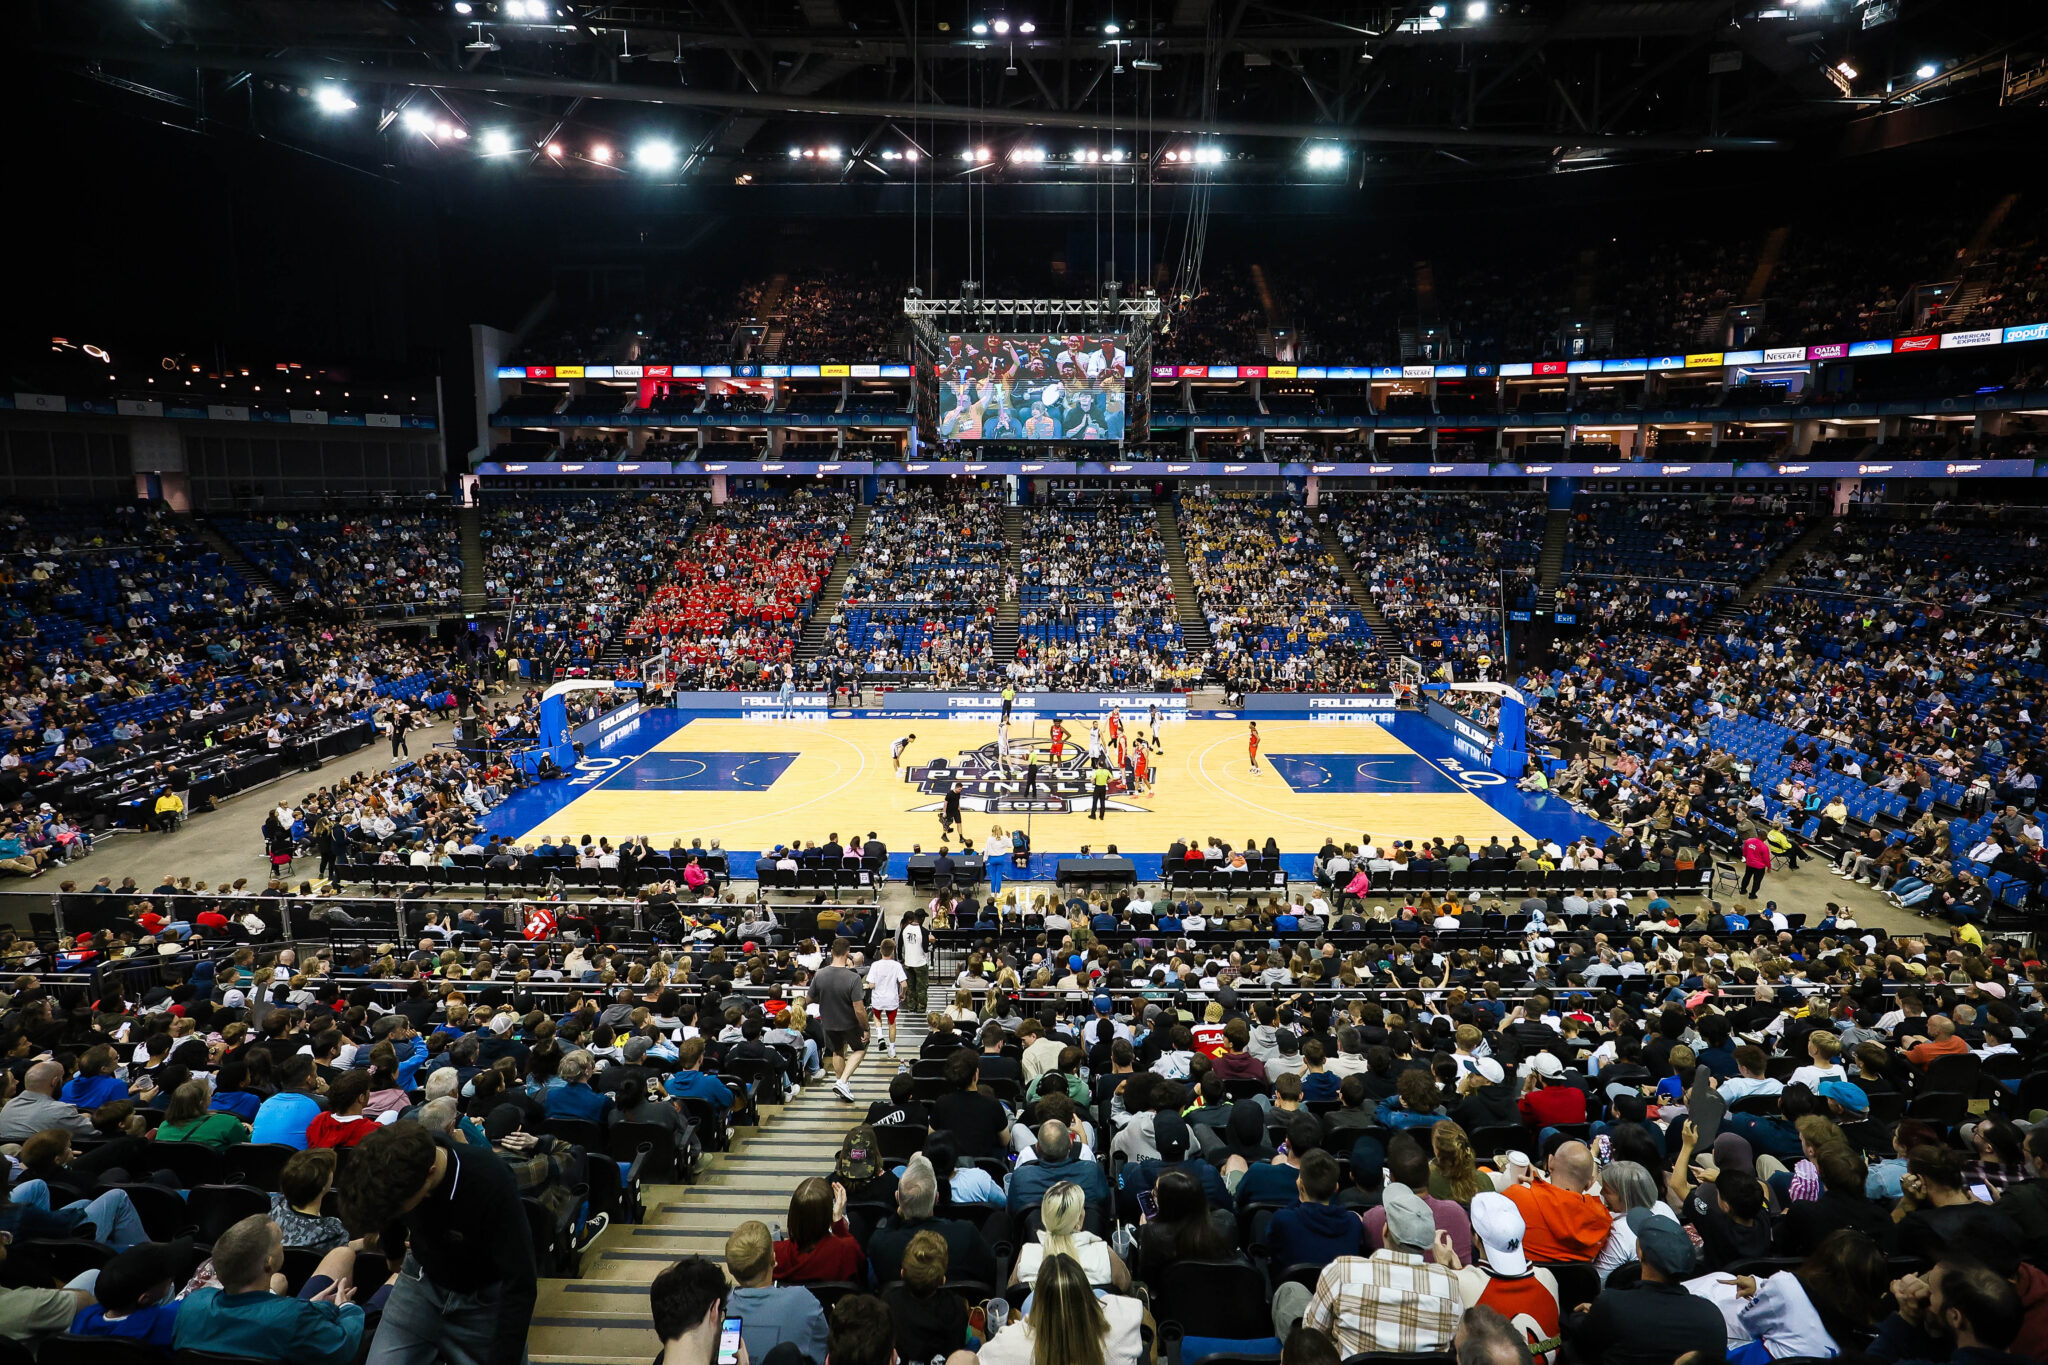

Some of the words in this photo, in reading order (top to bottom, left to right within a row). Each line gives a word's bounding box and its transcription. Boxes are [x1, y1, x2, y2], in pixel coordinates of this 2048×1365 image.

[1952, 332, 1990, 341] AMERICAN
[2007, 325, 2048, 341] gopuff
[1814, 345, 1841, 354] QATAR
[1557, 615, 1573, 623] Exit
[1436, 757, 1465, 772] The
[996, 801, 1062, 810] 2025
[1198, 1032, 1224, 1043] BLA
[1507, 1238, 1520, 1251] NY
